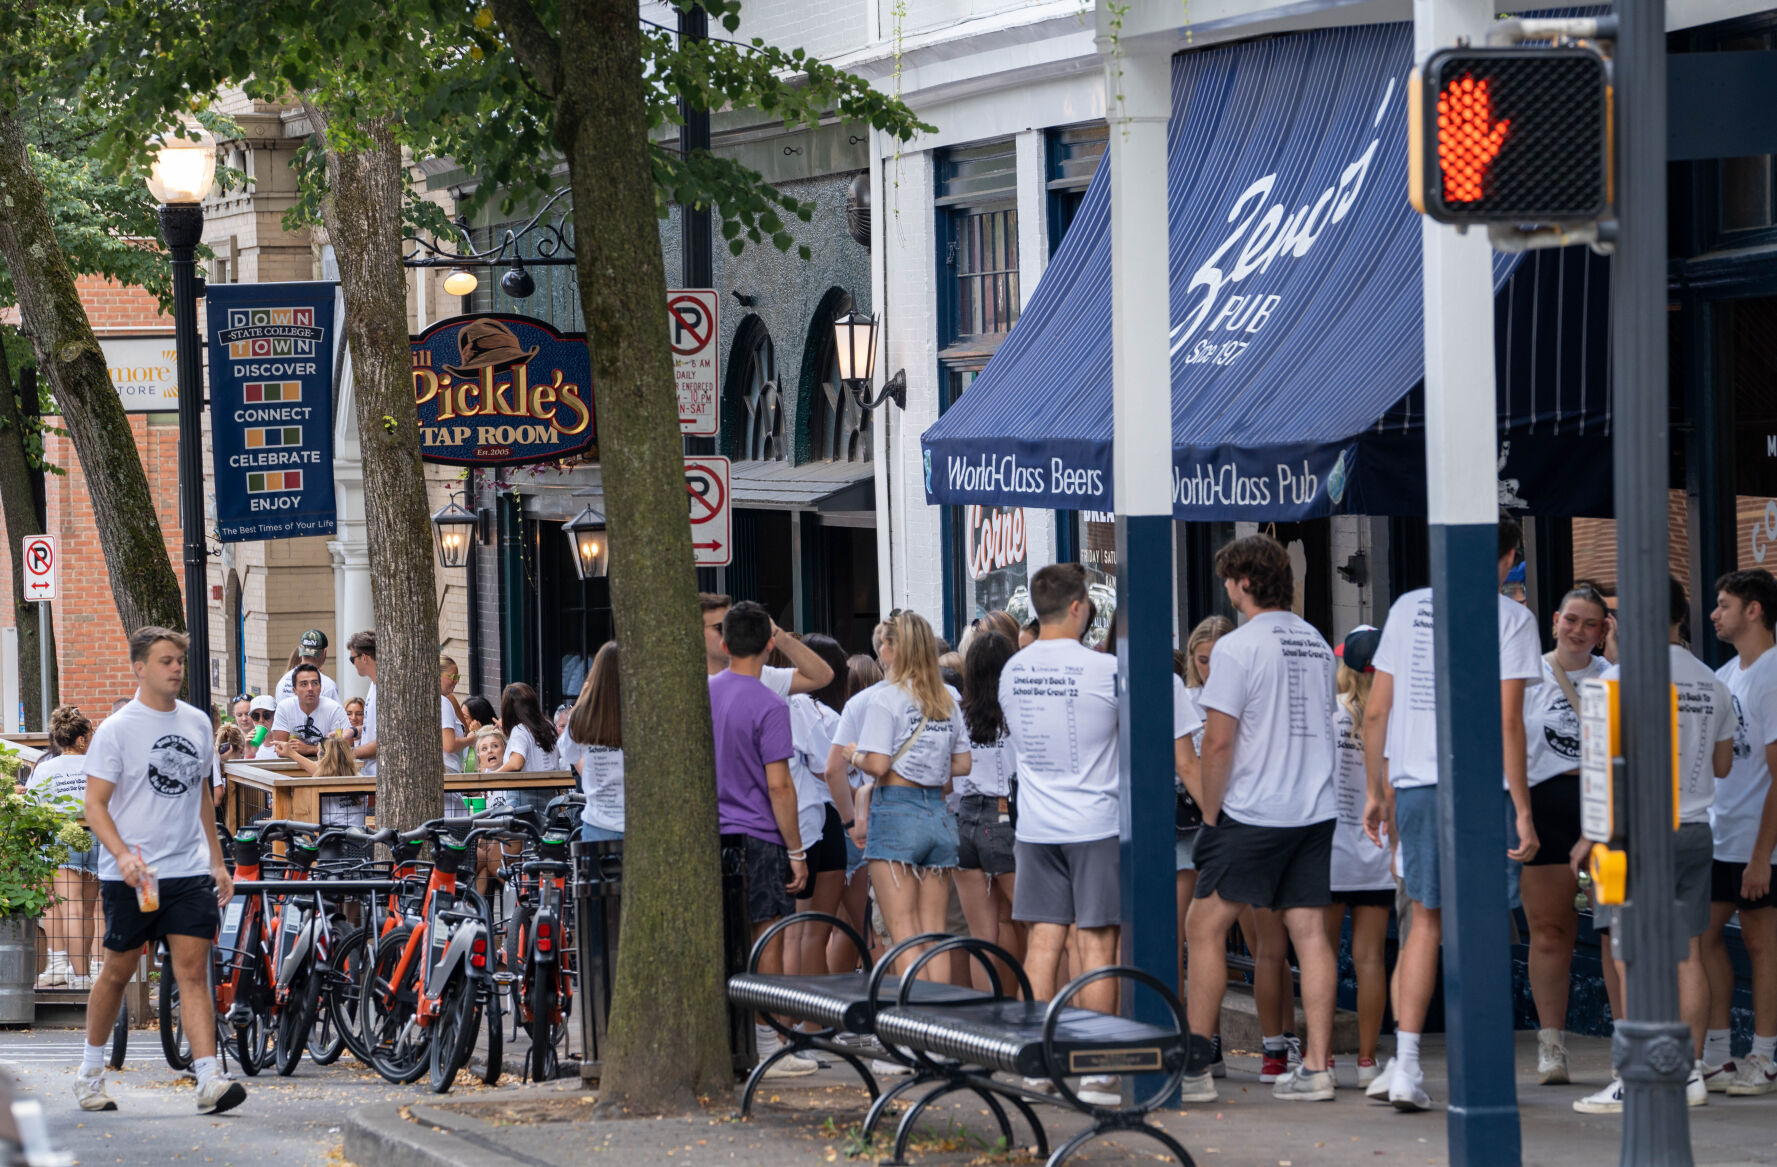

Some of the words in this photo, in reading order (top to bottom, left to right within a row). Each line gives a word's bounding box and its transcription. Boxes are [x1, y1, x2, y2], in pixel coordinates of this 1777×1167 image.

[234, 311, 310, 327] DOWN
[1207, 293, 1282, 333] PUB
[230, 328, 263, 339] STATE
[264, 326, 311, 338] COLLEGE
[236, 339, 310, 355] TOWN
[412, 350, 432, 367] ill
[699, 360, 711, 368] AM
[233, 363, 317, 378] DISCOVER
[676, 371, 697, 379] DAILY
[117, 386, 157, 396] TORE
[682, 382, 713, 391] ENFORCED
[411, 363, 590, 434] Pickle's
[701, 394, 712, 402] PM
[233, 407, 312, 423] CONNECT
[419, 426, 472, 447] TAP
[477, 426, 559, 446] ROOM
[229, 451, 321, 468] CELEBRATE
[947, 453, 1045, 494] World-Class
[1051, 457, 1104, 496] Beers
[1277, 460, 1318, 504] Pub
[250, 496, 302, 511] ENJOY
[222, 527, 238, 536] The
[239, 525, 257, 534] Best
[258, 523, 283, 532] Times
[284, 521, 294, 531] of
[295, 520, 316, 530] Your
[318, 519, 334, 528] Life
[967, 505, 1028, 579] Corne
